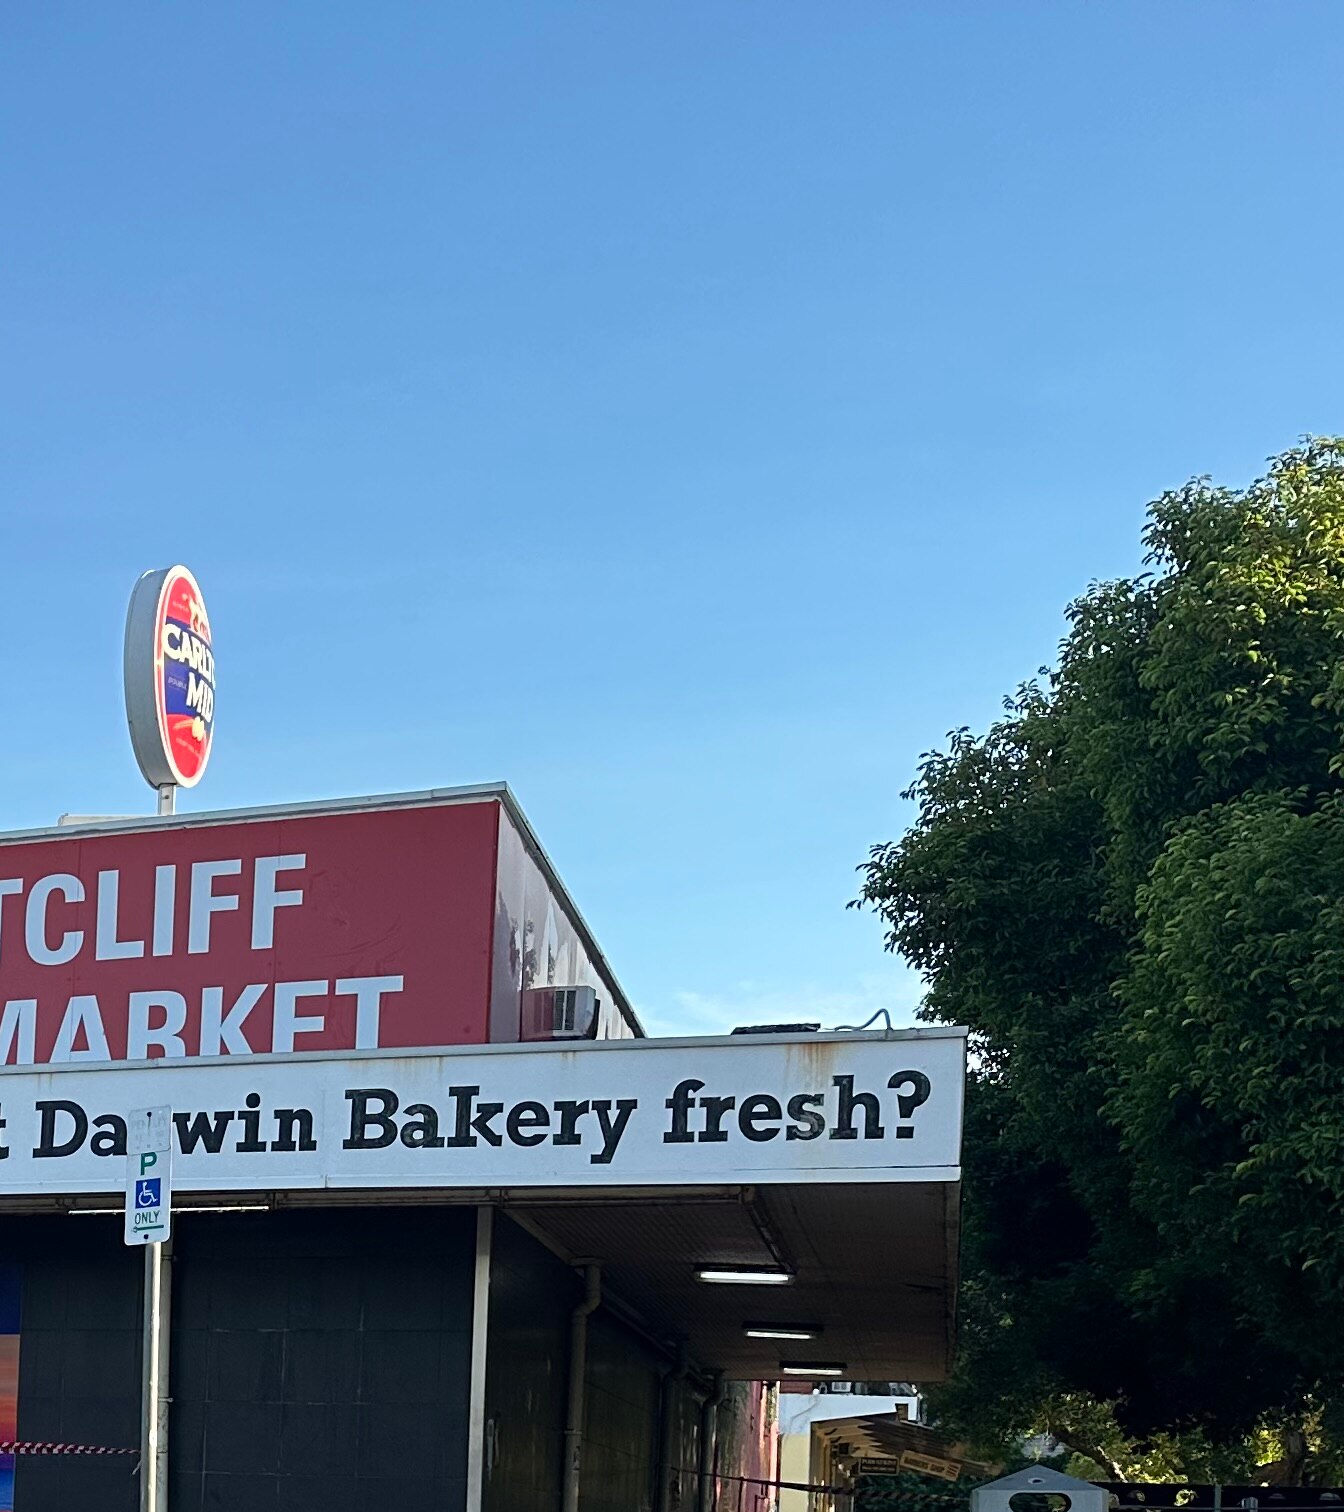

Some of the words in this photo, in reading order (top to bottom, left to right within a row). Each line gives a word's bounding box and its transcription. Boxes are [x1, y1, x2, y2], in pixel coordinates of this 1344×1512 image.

[186, 671, 212, 723] MID
[33, 1092, 317, 1159] Dawin
[343, 1086, 637, 1165] Bakery
[663, 1069, 932, 1144] fresh?
[141, 1152, 157, 1176] P
[135, 1210, 160, 1225] ONLY
